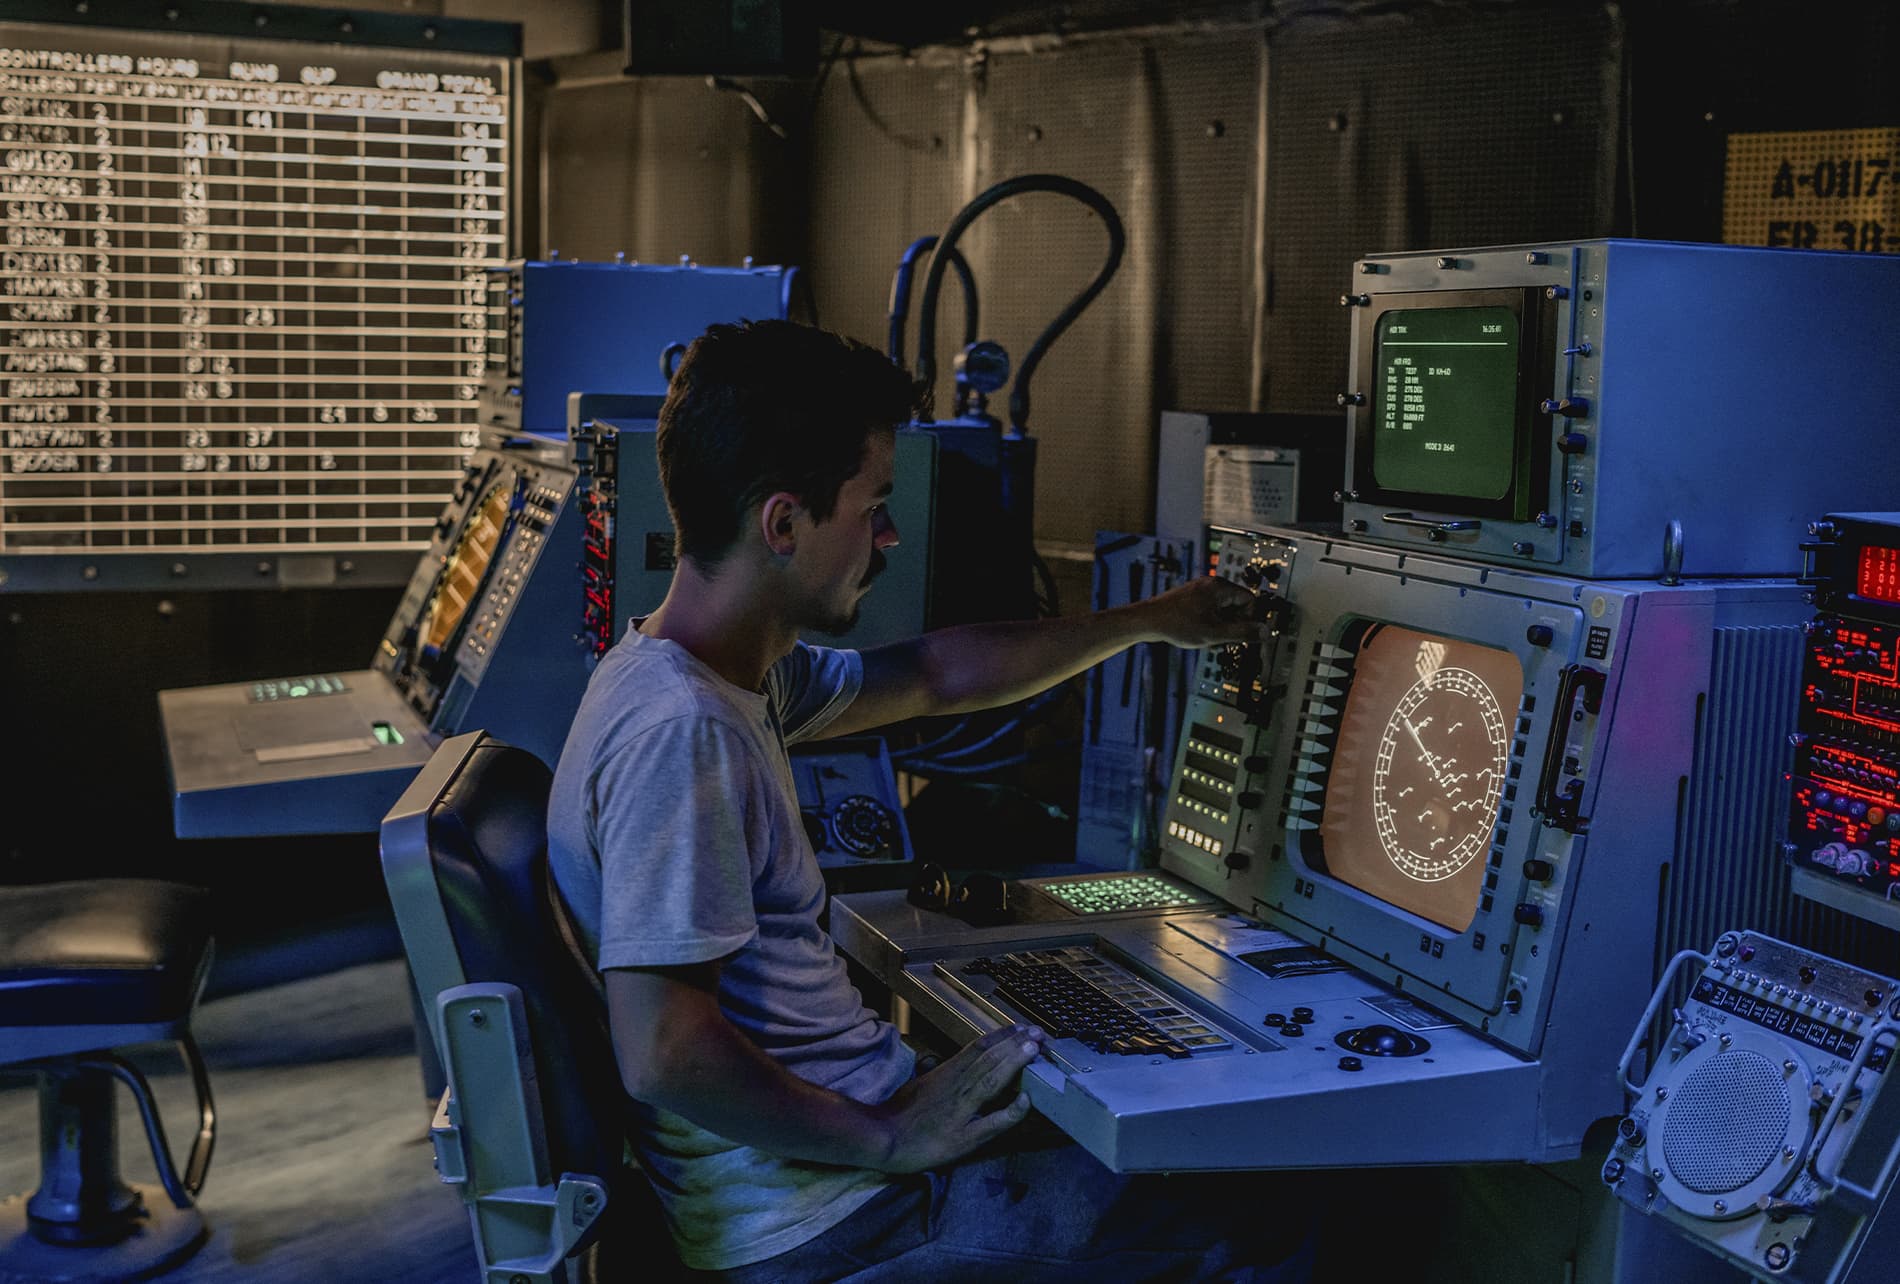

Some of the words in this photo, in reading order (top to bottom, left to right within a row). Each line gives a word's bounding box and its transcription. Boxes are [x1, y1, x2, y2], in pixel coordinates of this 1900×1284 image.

[0, 47, 134, 74] CONTROLLERS
[137, 55, 199, 79] HOURS
[376, 70, 440, 94] GRAND
[440, 74, 497, 96] TOTAL
[6, 149, 74, 172] GUIDO
[97, 152, 115, 176] 2
[97, 178, 115, 199] 2
[6, 200, 70, 223] SALSA
[96, 203, 114, 225] 2
[94, 228, 112, 251] 2
[3, 251, 83, 275] DEXTER
[95, 253, 113, 276] 2
[4, 277, 86, 300] HAMMER
[94, 277, 112, 300] 2
[95, 301, 112, 325] 2
[95, 330, 113, 351] 2
[5, 350, 88, 375] MUSTANG
[99, 351, 116, 374] 2
[97, 376, 113, 398] 2
[8, 401, 70, 422] HUTCH
[96, 401, 113, 423] 2
[96, 426, 114, 449] 2
[246, 426, 274, 448] 37
[1865, 558, 1871, 569] 2
[1864, 570, 1870, 581] 3
